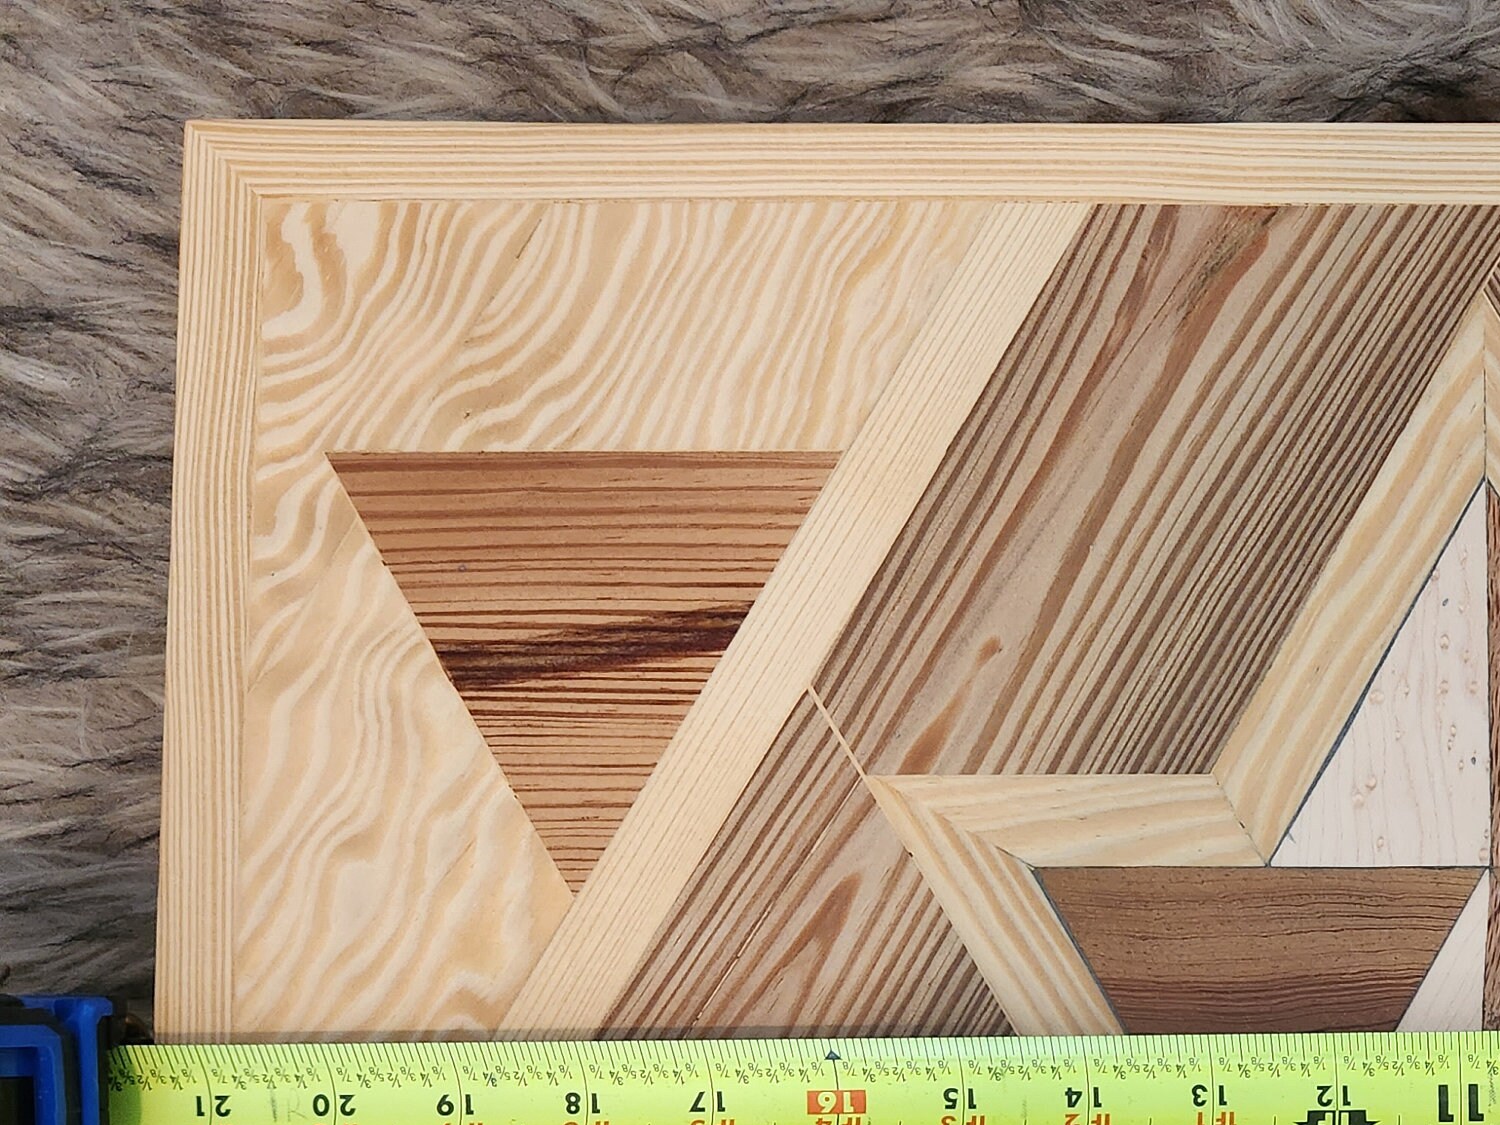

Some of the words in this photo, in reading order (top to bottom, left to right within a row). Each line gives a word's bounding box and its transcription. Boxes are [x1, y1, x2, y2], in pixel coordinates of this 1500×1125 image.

[194, 1095, 230, 1117] 21
[312, 1094, 356, 1117] 20
[436, 1094, 474, 1116] 19
[565, 1092, 600, 1114] 18
[690, 1091, 726, 1112] 17
[817, 1091, 851, 1114] 16
[943, 1088, 976, 1110] 15
[1064, 1086, 1102, 1108] 14
[1191, 1084, 1227, 1106] 13
[1316, 1085, 1351, 1106] 12
